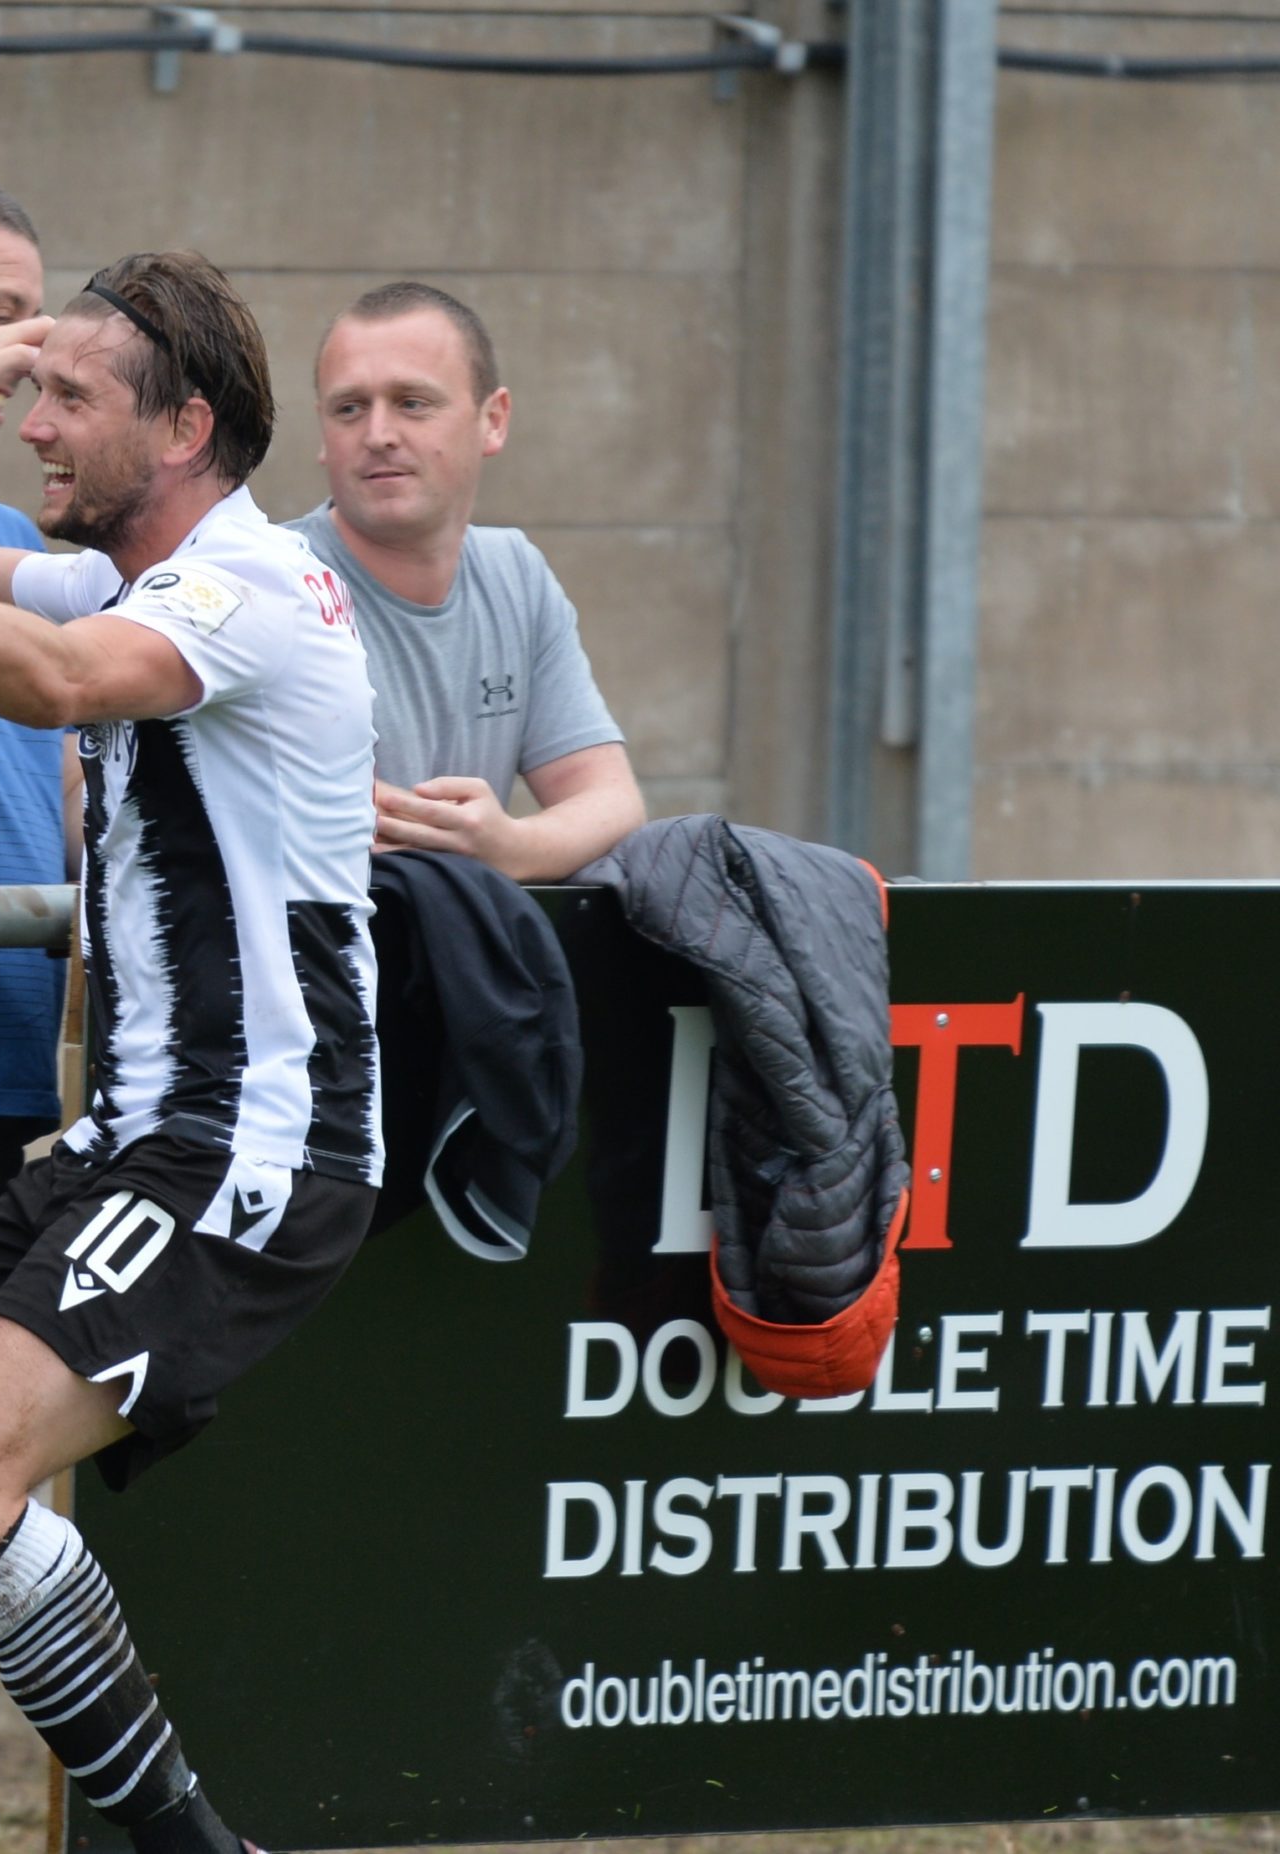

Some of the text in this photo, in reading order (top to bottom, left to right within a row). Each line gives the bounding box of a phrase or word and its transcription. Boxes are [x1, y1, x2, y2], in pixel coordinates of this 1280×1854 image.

[64, 1190, 176, 1294] 10
[563, 1306, 1271, 1418] DOLE TIME
[543, 1463, 1271, 1579] DISTRIBUTION
[561, 1646, 1237, 1729] doubletimedistribution.com
